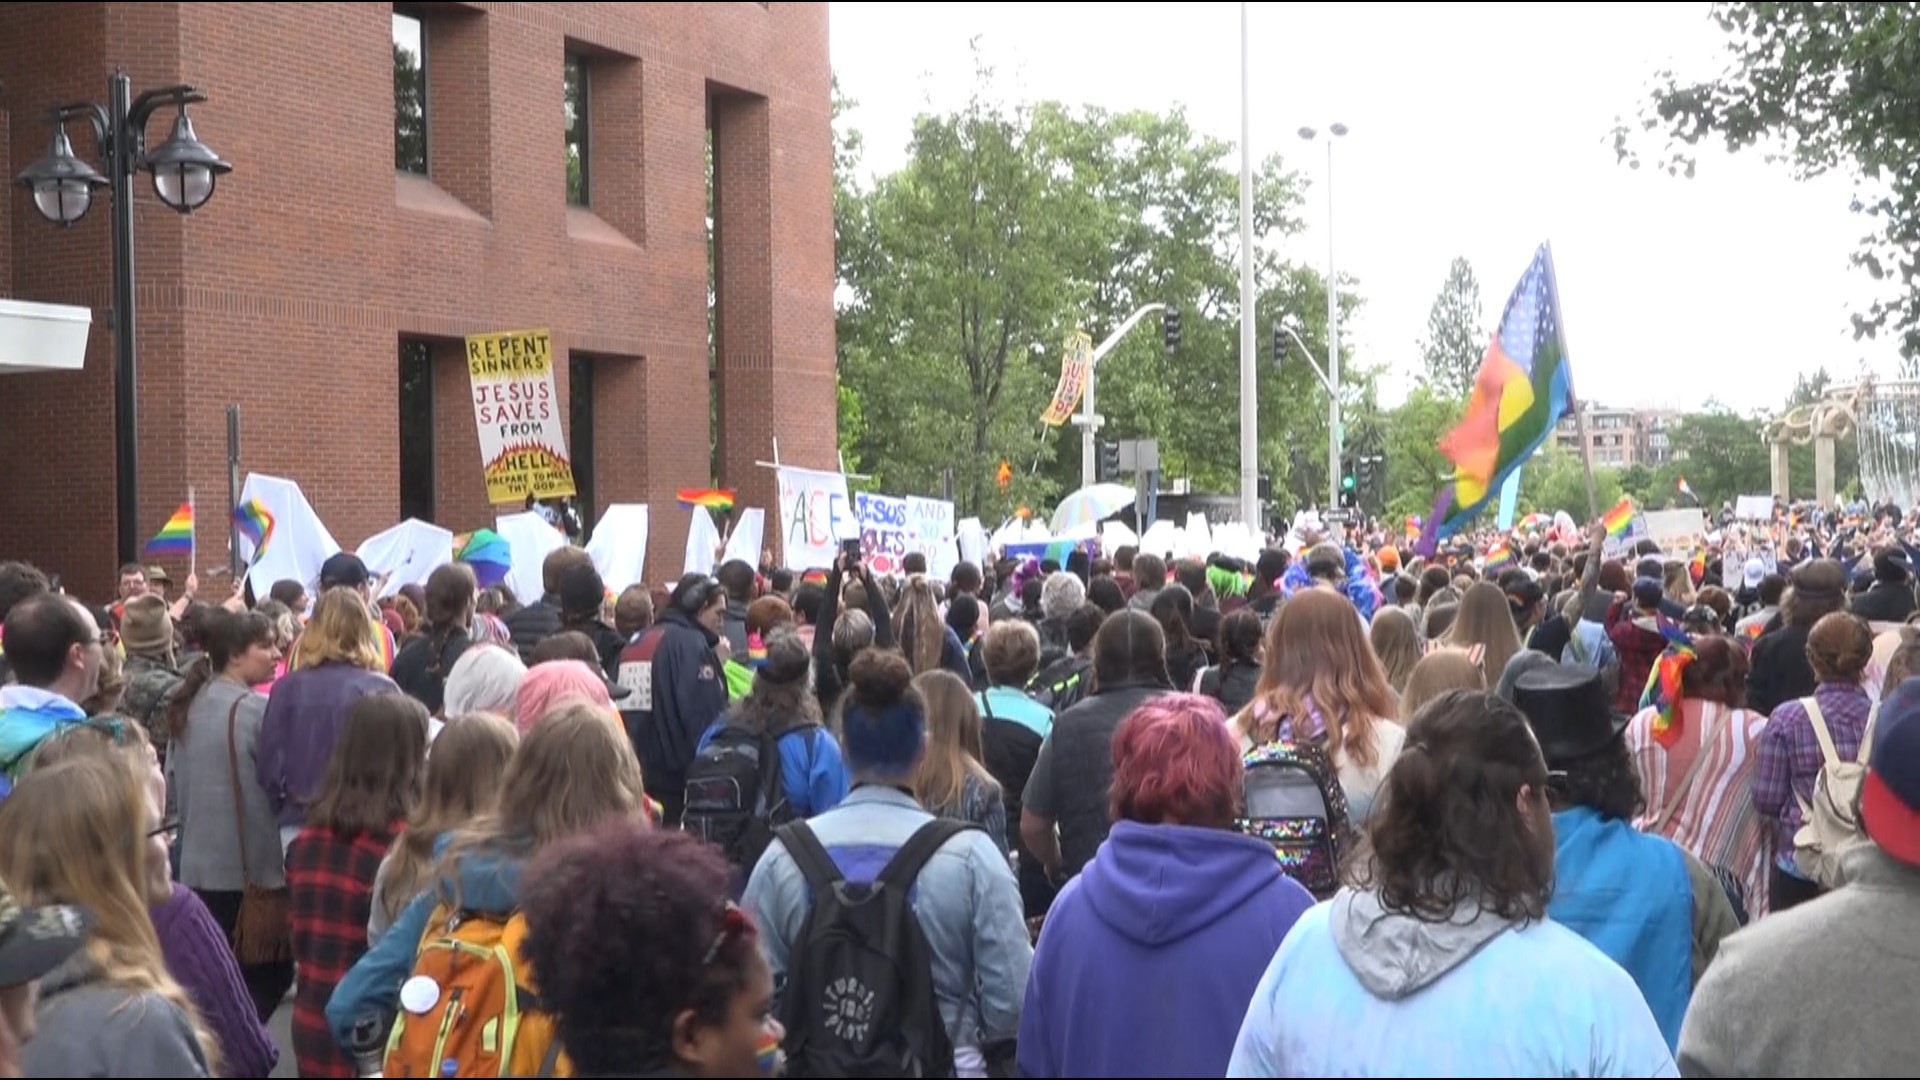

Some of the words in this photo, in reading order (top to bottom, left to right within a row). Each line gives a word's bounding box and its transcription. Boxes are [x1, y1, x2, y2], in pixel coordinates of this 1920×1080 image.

[469, 336, 548, 360] REPENT
[472, 355, 544, 375] SINNERS
[476, 381, 549, 404] JESUS
[480, 401, 549, 424] SAVES
[500, 422, 543, 438] FROM
[506, 453, 551, 471] HELL
[487, 473, 528, 486] PREPARE
[534, 472, 545, 481] TO
[547, 470, 570, 479] MEET
[509, 484, 527, 493] THY
[533, 481, 555, 491] GOD
[857, 495, 906, 527] JESUS
[914, 502, 946, 521] AND
